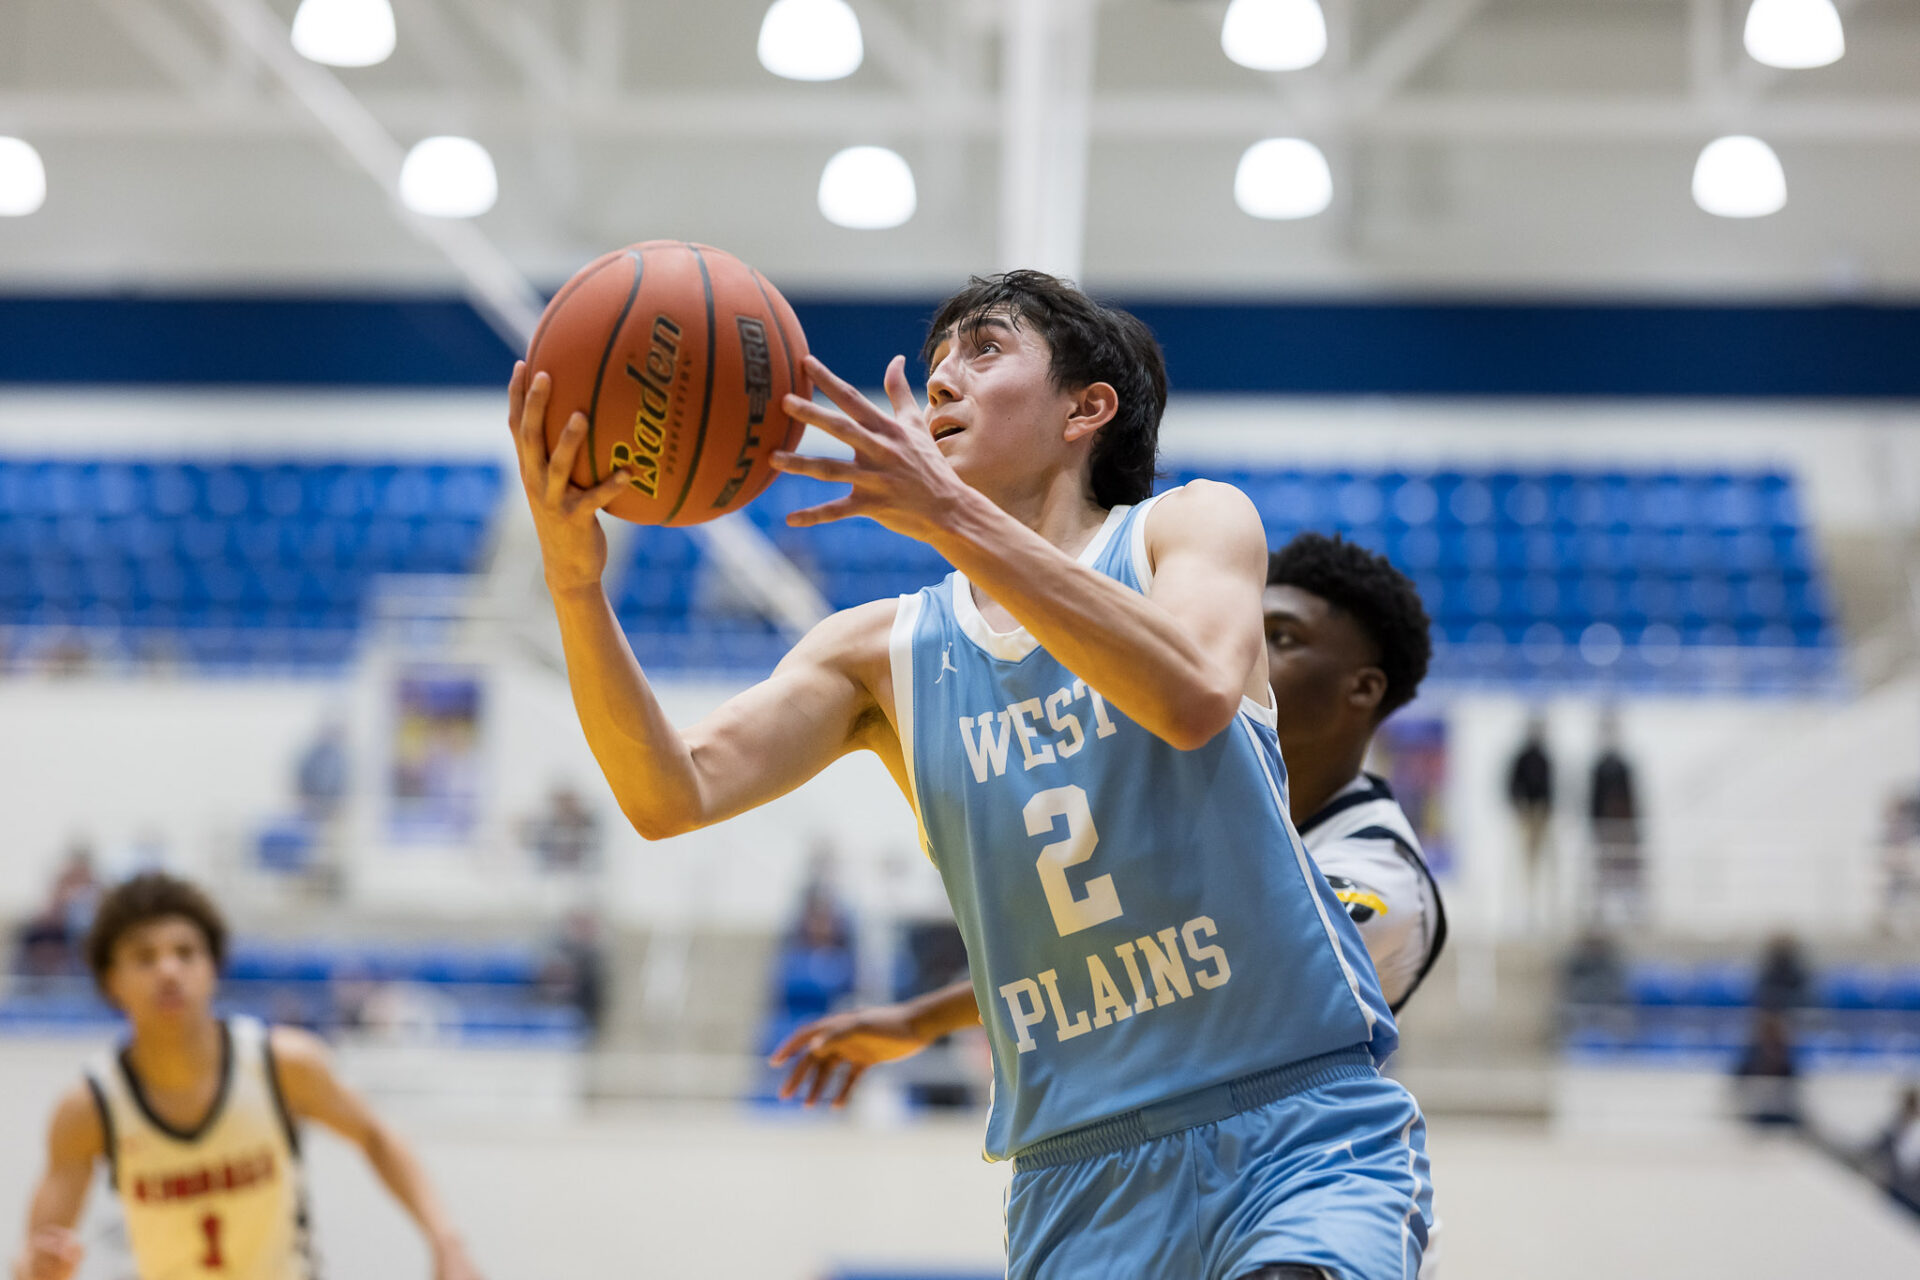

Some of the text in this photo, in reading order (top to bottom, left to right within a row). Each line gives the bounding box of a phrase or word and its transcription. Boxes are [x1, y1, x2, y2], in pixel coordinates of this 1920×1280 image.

[609, 314, 682, 499] Baden
[739, 319, 770, 387] PRO
[958, 677, 1118, 784] WEST
[1022, 783, 1124, 938] 2
[998, 914, 1232, 1055] PLAINS
[200, 1212, 224, 1269] 1
